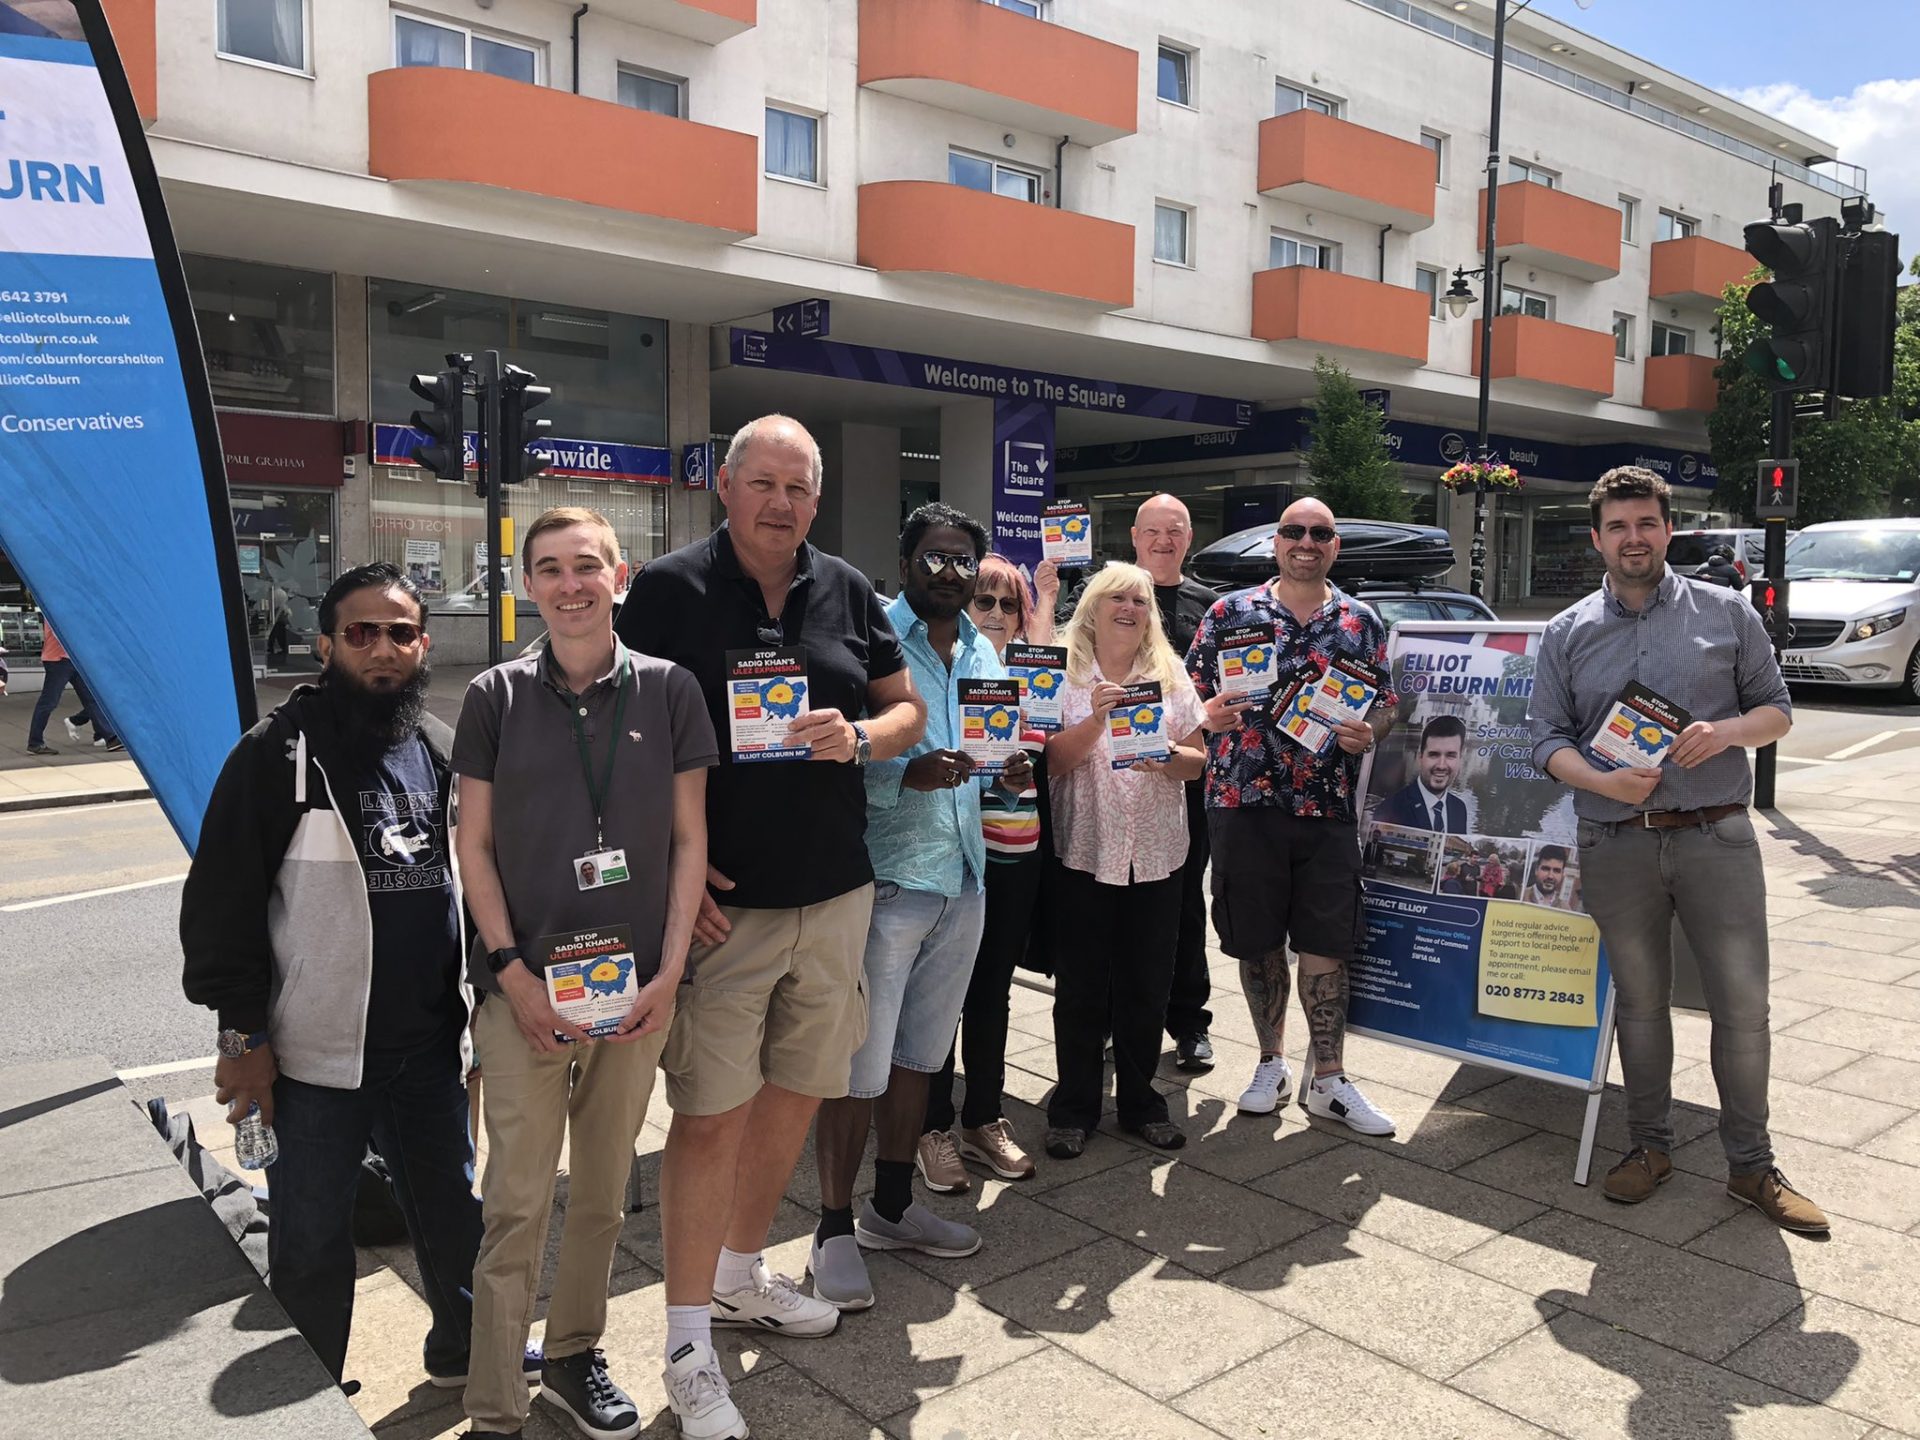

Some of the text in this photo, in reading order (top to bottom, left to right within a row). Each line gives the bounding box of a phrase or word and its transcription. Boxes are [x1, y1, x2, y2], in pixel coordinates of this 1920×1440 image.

[0, 291, 68, 303] 642 3791
[924, 363, 1126, 409] Welcome to The Square
[1, 412, 144, 433] Conservatives
[1194, 430, 1238, 446] beauty
[226, 454, 305, 468] PAUL GRAHAM
[1509, 448, 1539, 467] beauty
[1011, 461, 1029, 472] The
[1635, 455, 1673, 474] pharmacy
[1010, 473, 1044, 486] Square
[996, 511, 1039, 524] Welcome
[996, 526, 1014, 537] The
[755, 651, 777, 659] STOP
[1785, 655, 1805, 665] XKA
[737, 658, 796, 668] SADIQ KHAN'S
[1403, 653, 1473, 673] ELLIOT
[732, 665, 801, 676] ULEZ EXPANSION
[1400, 674, 1499, 696] COLBURN
[989, 688, 1012, 696] KHAN'S
[1634, 695, 1679, 724] SADIQ KHAN'S
[1651, 697, 1669, 710] STOP
[739, 752, 761, 760] ELLIOT
[761, 751, 794, 759] COLBURN
[1478, 744, 1531, 760] of Car
[363, 793, 440, 810] LACOSTE
[1398, 901, 1428, 914] ELLIOT
[1497, 920, 1513, 928] hold
[1515, 921, 1542, 931] regular
[1544, 923, 1569, 932] advice
[574, 932, 598, 942] STOP
[1491, 930, 1595, 944] surgeries offering help and
[555, 936, 620, 953] SADIQ KHAN'S
[1413, 943, 1435, 953] London
[1441, 939, 1469, 951] Commons
[1490, 938, 1520, 948] support
[1522, 940, 1530, 948] to
[1531, 941, 1550, 950] local
[549, 942, 626, 961] ULEZ EXPANSION
[1489, 949, 1497, 958] To
[1499, 952, 1529, 961] arrange
[1486, 970, 1499, 978] me
[1541, 964, 1567, 974] please
[1568, 967, 1592, 976] email
[1485, 984, 1585, 1005] 020 8773 2843
